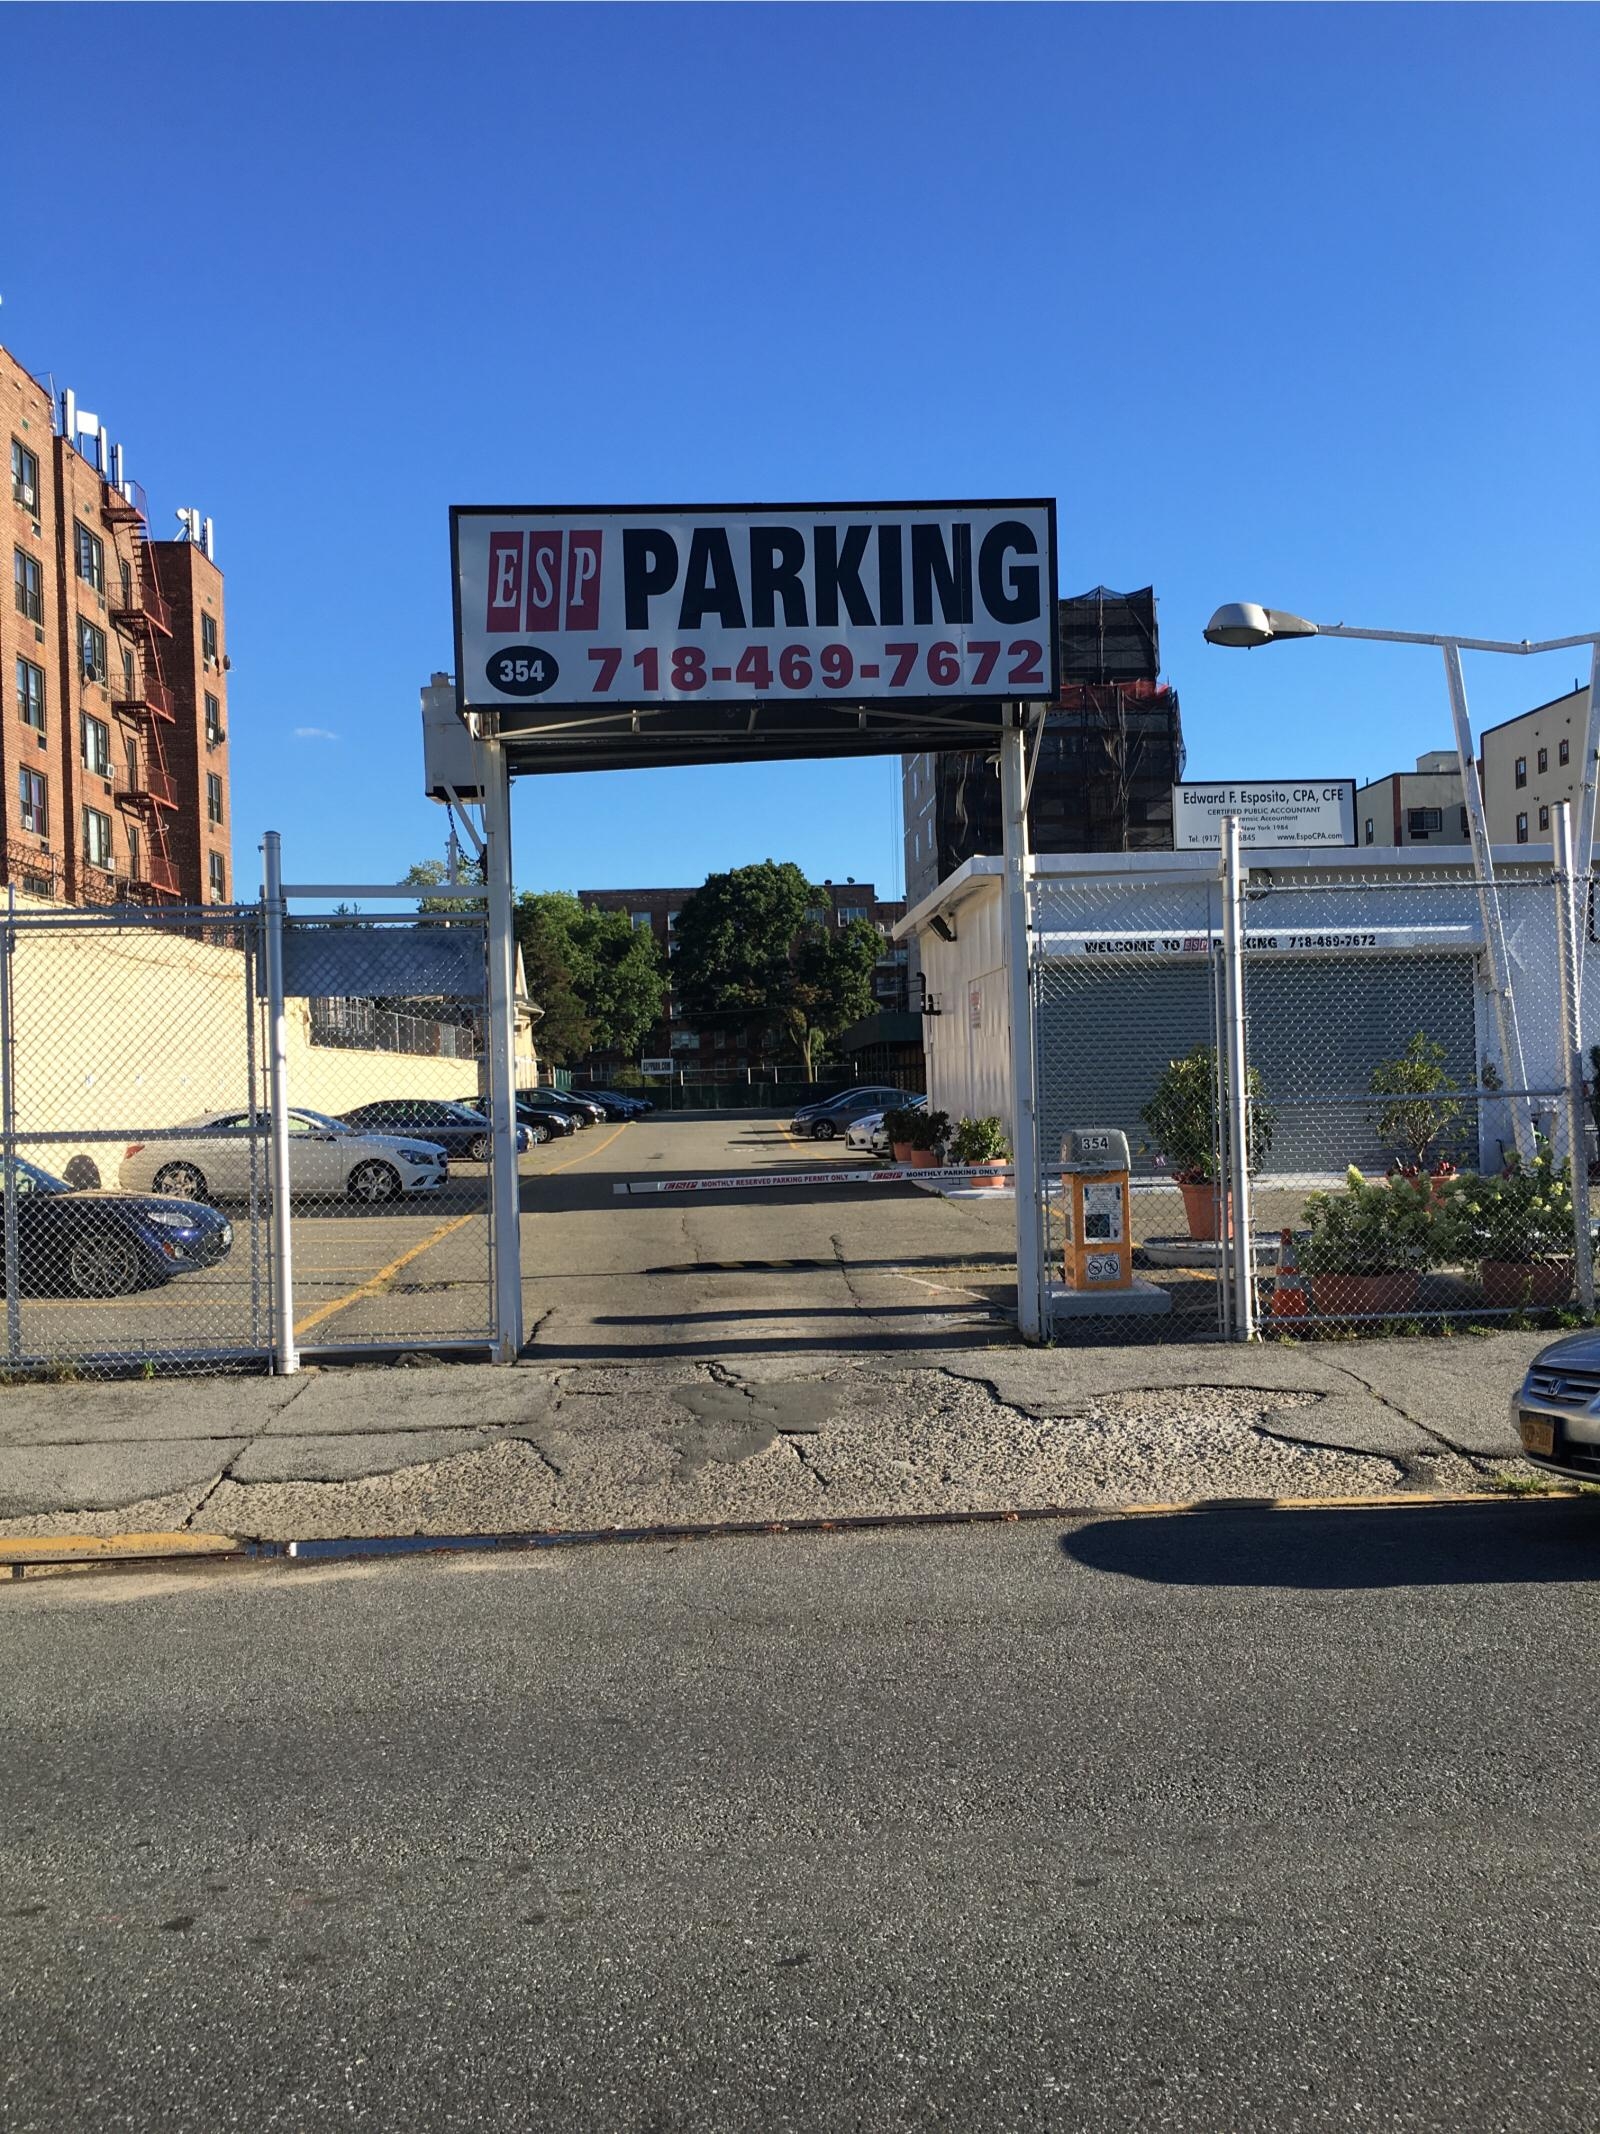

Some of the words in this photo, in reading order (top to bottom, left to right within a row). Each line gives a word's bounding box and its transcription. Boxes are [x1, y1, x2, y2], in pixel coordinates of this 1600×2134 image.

[490, 540, 598, 610] ESP
[622, 520, 1041, 631] PARKING
[499, 658, 545, 682] 354
[587, 640, 1044, 692] 718-469-7672
[1183, 791, 1226, 805] Edward
[1229, 791, 1237, 804] F.
[1241, 789, 1290, 806] Esposito,
[1292, 788, 1319, 804] CPA,
[1322, 788, 1344, 801] CFE
[1207, 808, 1242, 816] CERTIFIED
[1244, 807, 1269, 815] PUBLIC
[1270, 806, 1321, 814] ACCOUNTANT
[1276, 832, 1343, 841] www.EspoCPA.com
[1084, 940, 1155, 953] WELCOME
[1162, 939, 1180, 951] TO
[1183, 939, 1208, 951] ESP
[1213, 937, 1278, 949] PKING
[1289, 935, 1376, 948] 718-469-7672
[1083, 1138, 1109, 1149] 354
[906, 1170, 942, 1178] MONTHLY
[943, 1169, 977, 1177] PARKING
[979, 1168, 999, 1176] ONLY
